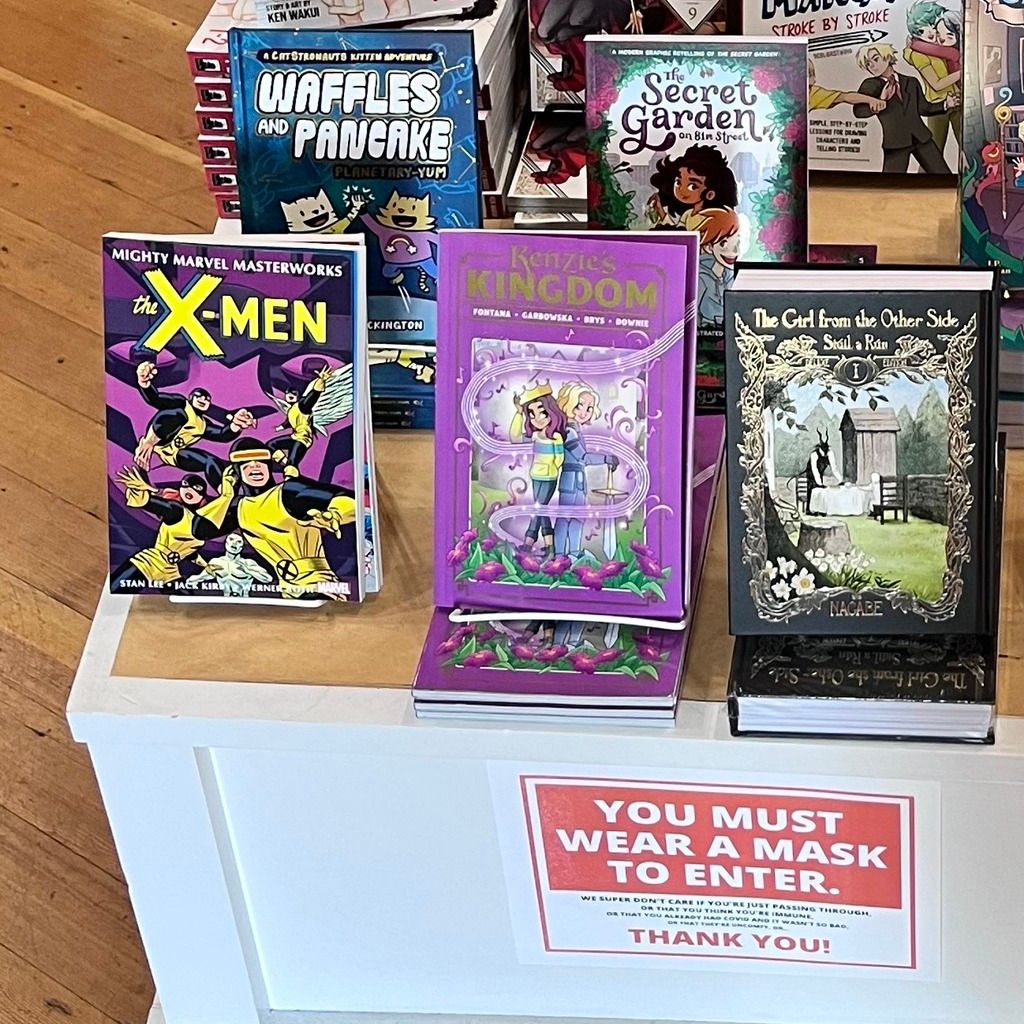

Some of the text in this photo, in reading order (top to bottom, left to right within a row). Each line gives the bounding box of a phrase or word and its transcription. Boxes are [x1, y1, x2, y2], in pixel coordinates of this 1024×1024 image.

[267, 7, 320, 23] KEN WAKUI
[688, 6, 698, 21] 9
[772, 8, 889, 36] STROKE BY STROKE
[271, 51, 433, 62] CATSTRONAUTS KITTEN ADVENTURE
[663, 67, 685, 82] The
[255, 69, 441, 116] WAFFLES
[641, 72, 757, 106] Secret
[257, 118, 453, 163] AND PANCAKE
[619, 103, 763, 155] Garden
[678, 131, 749, 144] on Street
[335, 165, 448, 179] PLANETARY-YUM
[112, 248, 343, 277] MIGHTY MARVEL MASTERWORKS
[510, 245, 617, 272] Kenzie's
[466, 269, 657, 309] KINGDOM
[132, 267, 328, 360] the X-MEN
[473, 308, 649, 328] FONTANA GARBOWSKA DOWNIE
[752, 308, 959, 328] The Girl from the Other Side
[120, 579, 198, 590] STAN LEE JACK
[317, 582, 350, 594] MARVEL
[829, 600, 884, 617] NAGABE
[594, 799, 844, 834] YOU MUST
[555, 829, 888, 869] WEAR A MASK
[607, 860, 840, 895] TO ENTER.
[668, 898, 693, 906] CARE
[772, 904, 816, 912] PASSING
[819, 907, 871, 917] THROUGH,
[628, 928, 831, 954] THANK YOU!
